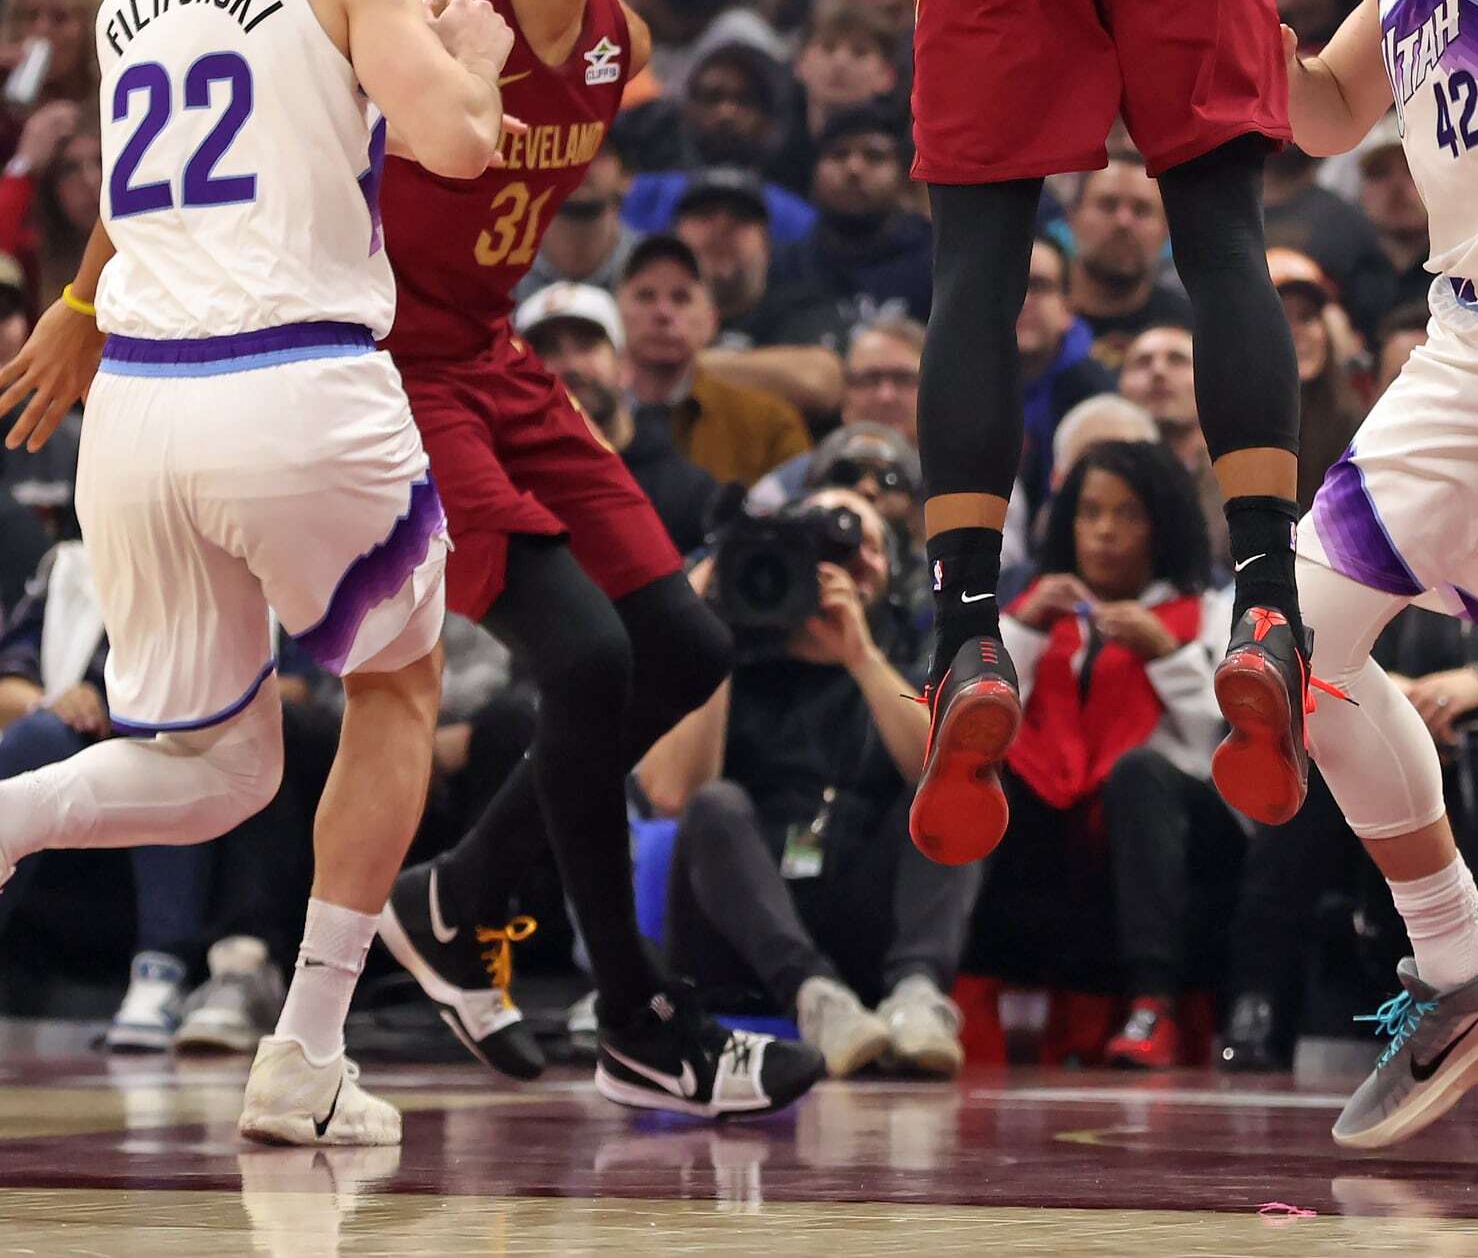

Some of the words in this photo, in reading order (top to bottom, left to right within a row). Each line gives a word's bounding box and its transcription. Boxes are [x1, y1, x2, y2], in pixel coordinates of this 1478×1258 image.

[109, 50, 258, 221] 22
[495, 121, 605, 170] LEVELAND
[473, 181, 557, 266] 31
